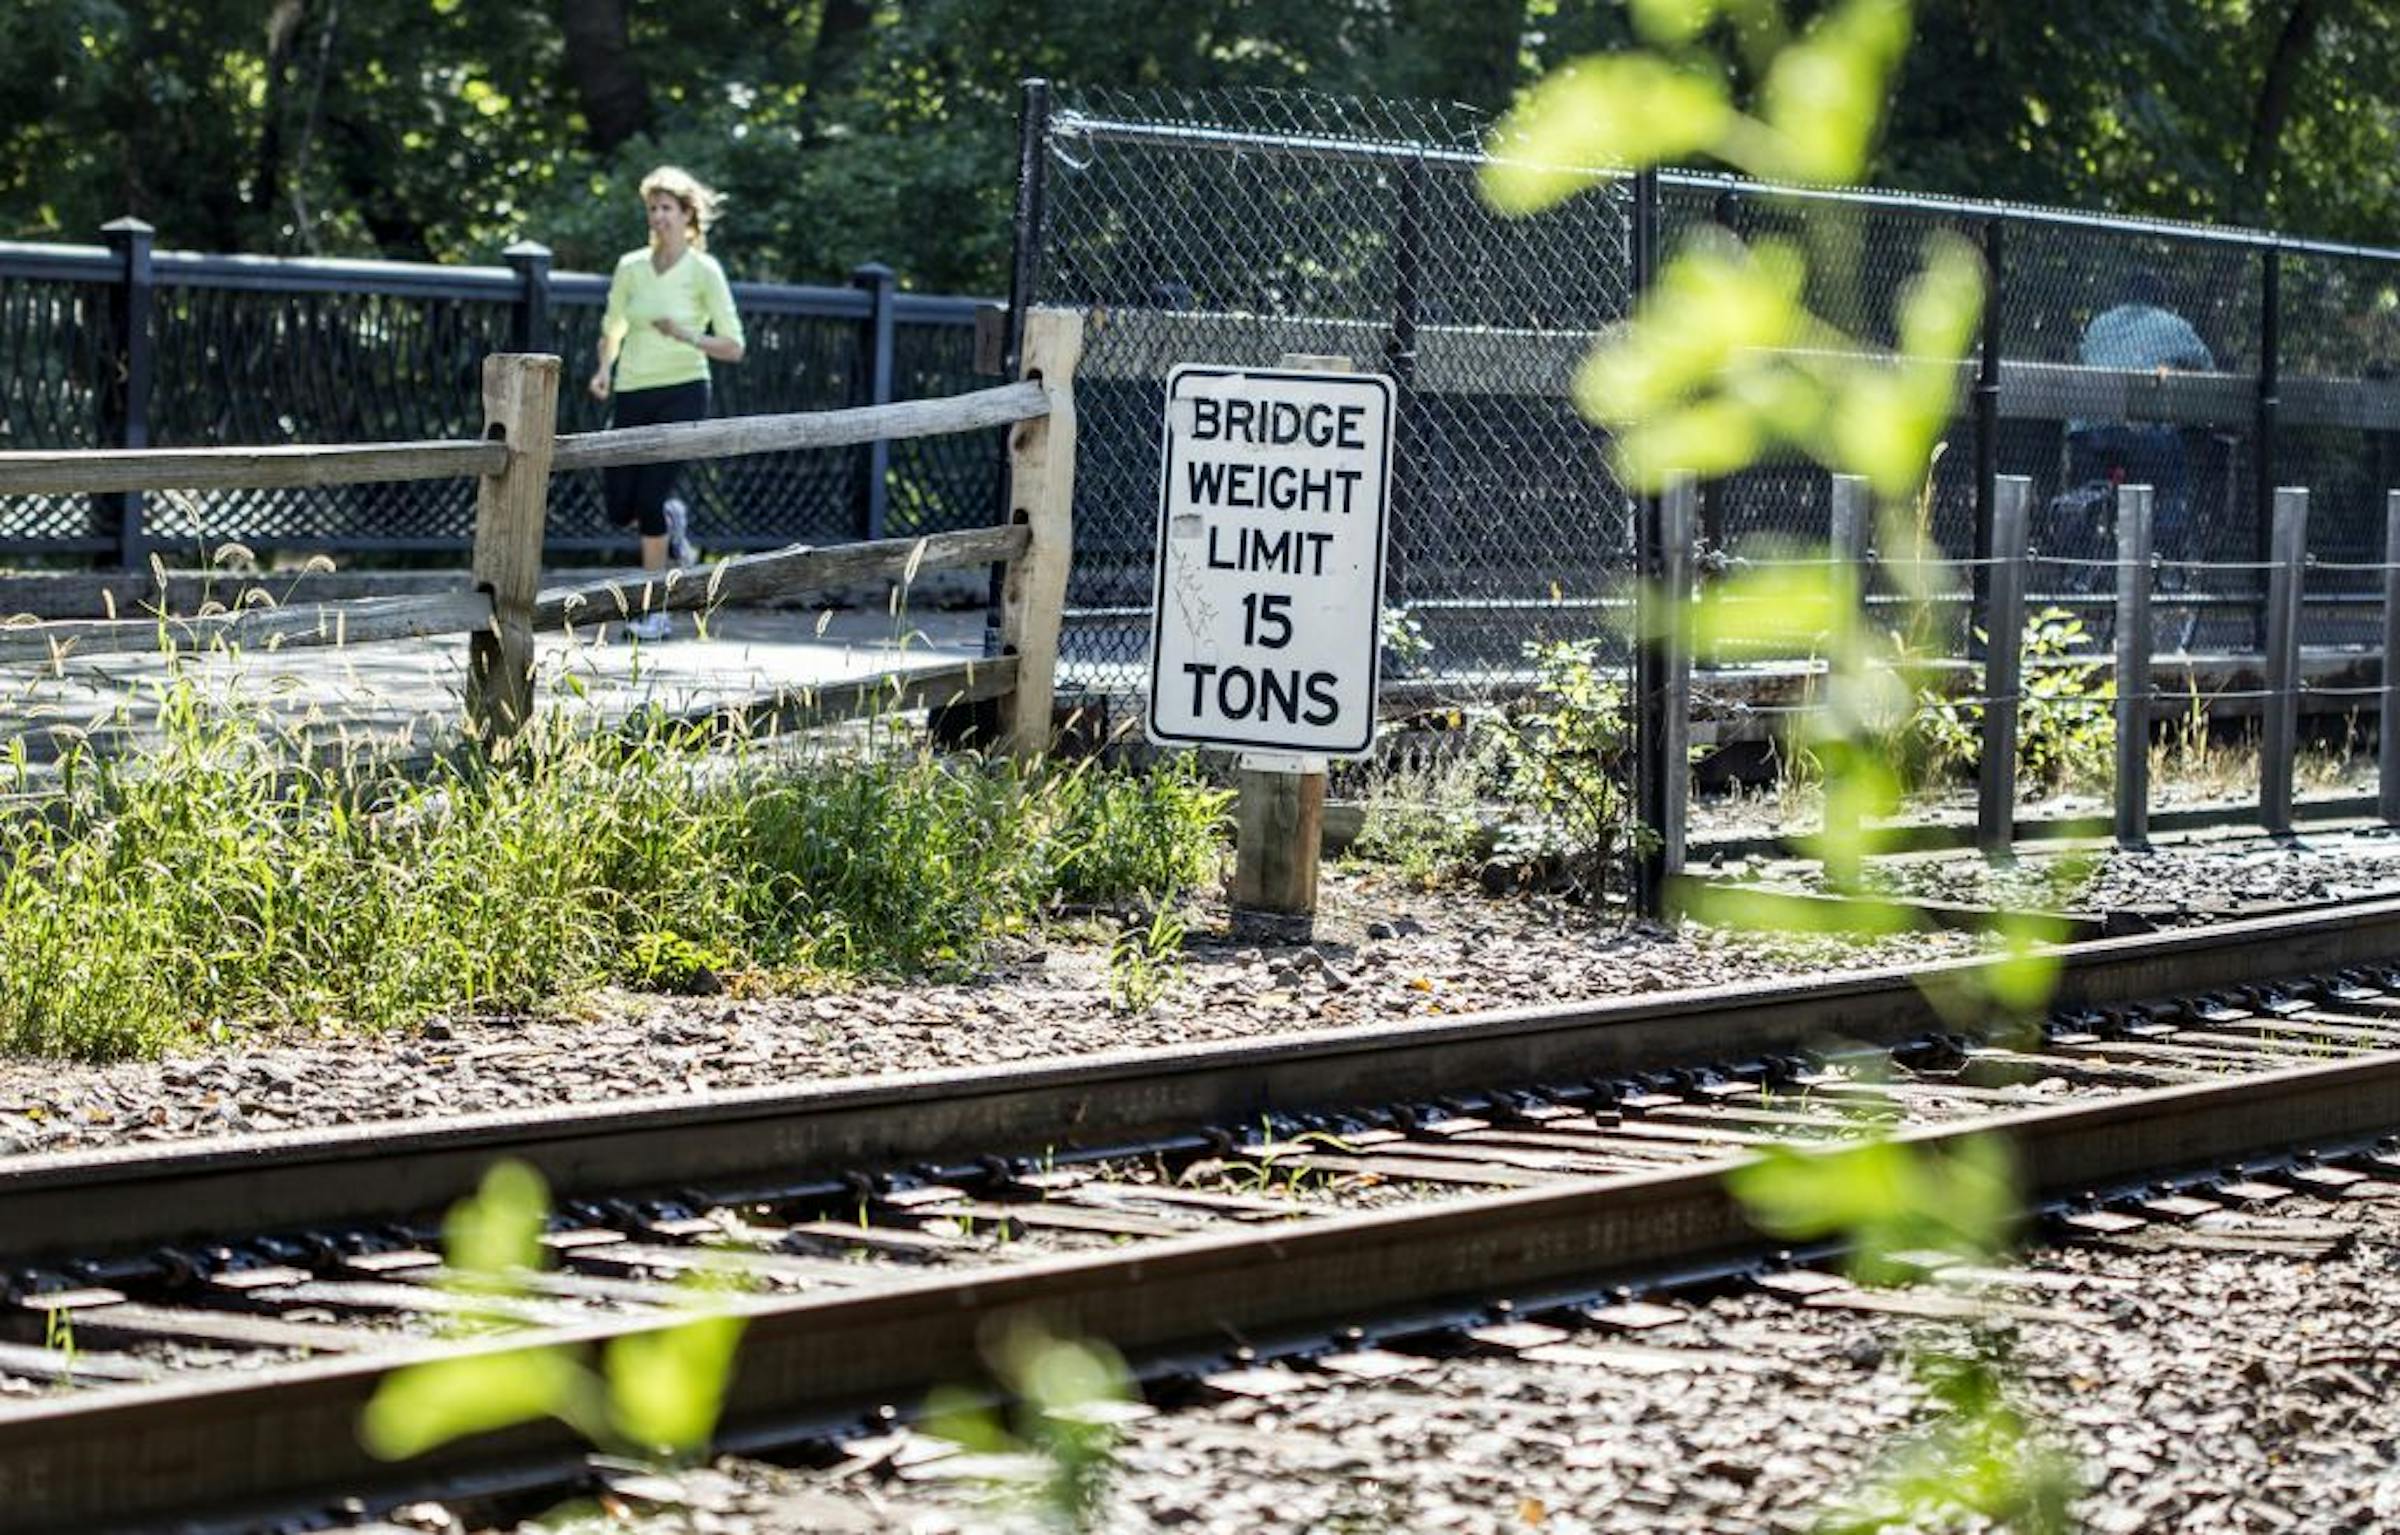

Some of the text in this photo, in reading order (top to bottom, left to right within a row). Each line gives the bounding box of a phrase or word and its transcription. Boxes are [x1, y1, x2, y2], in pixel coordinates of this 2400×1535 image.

[1192, 397, 1366, 449] BRIDGE
[1188, 461, 1361, 513] WEIGHT
[1208, 525, 1333, 575] LIMIT
[1242, 592, 1292, 648] 15
[1183, 663, 1339, 726] TONS
